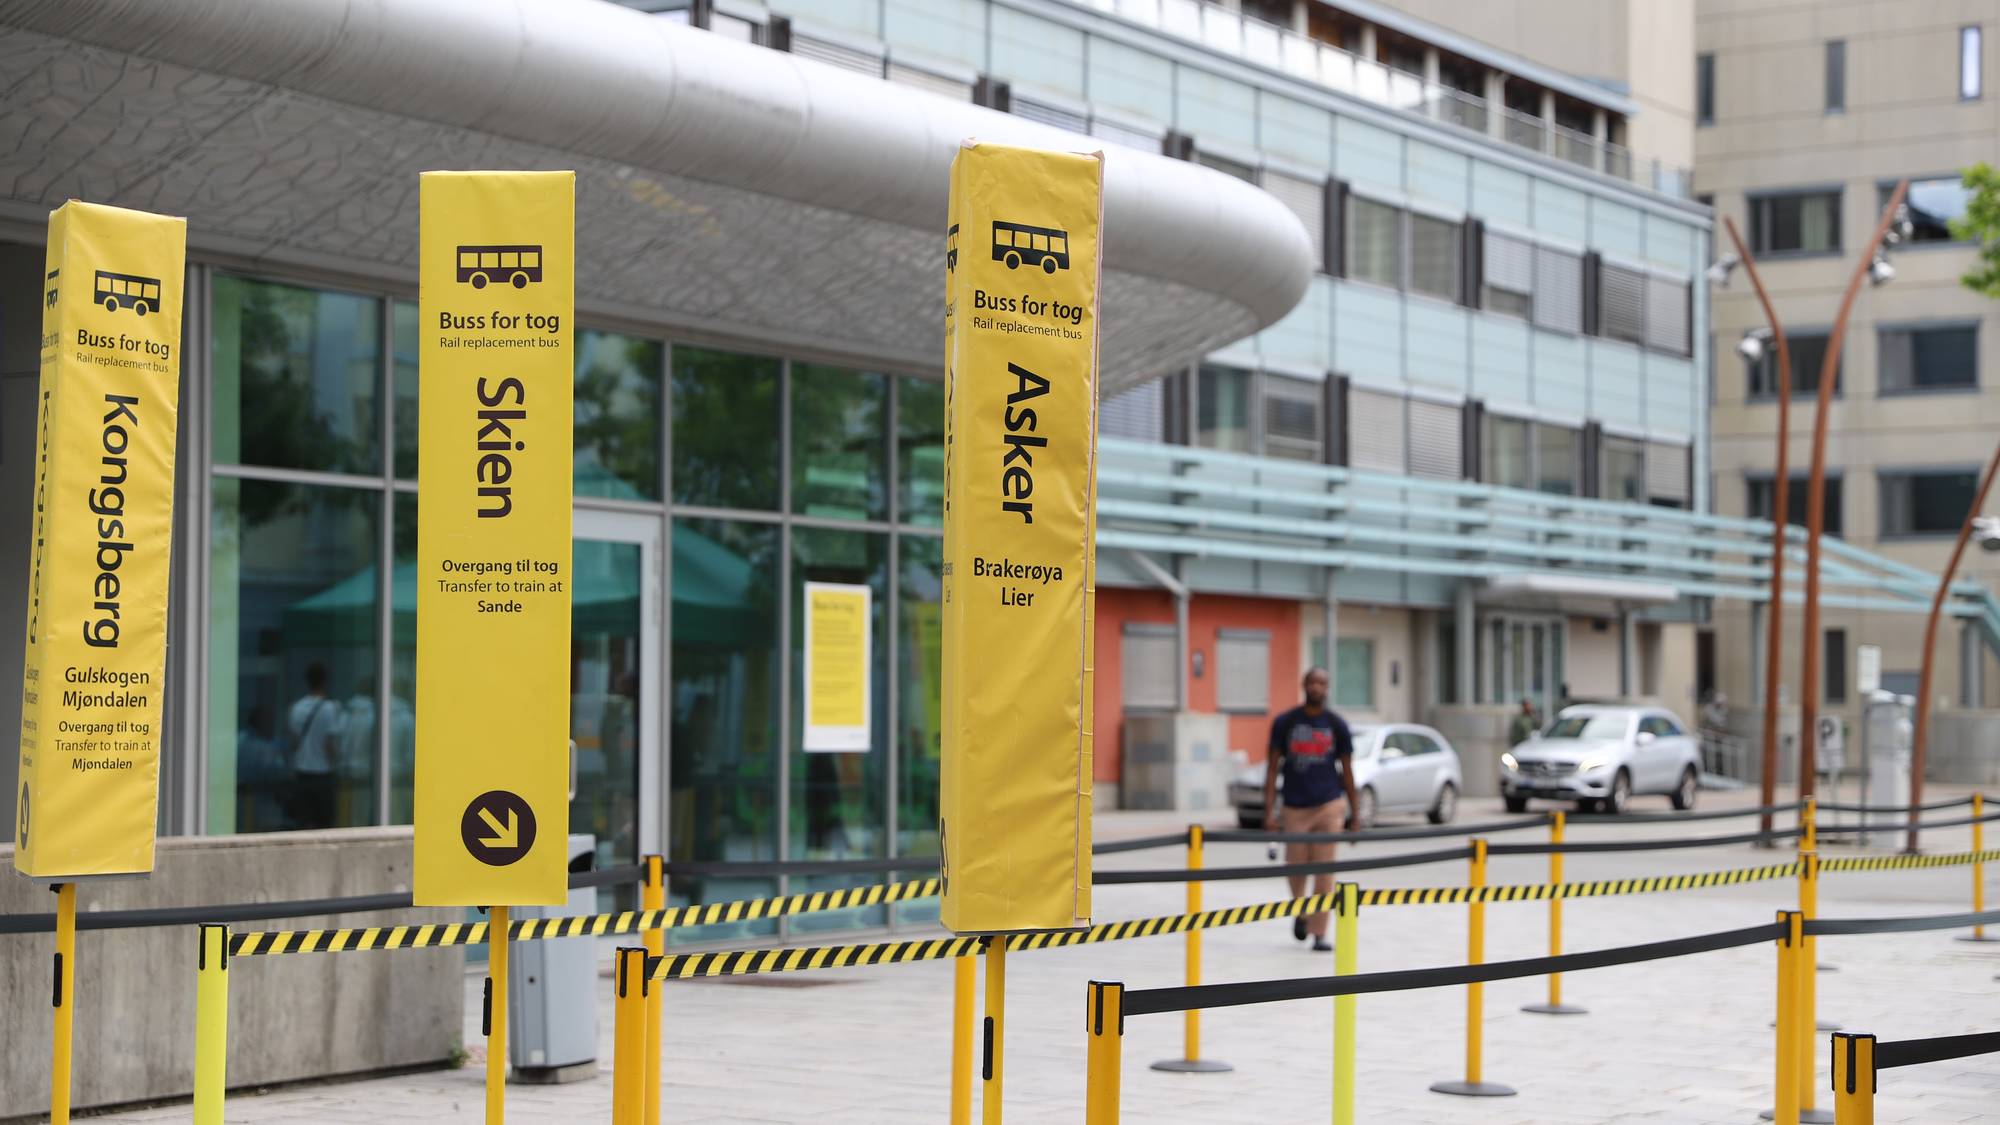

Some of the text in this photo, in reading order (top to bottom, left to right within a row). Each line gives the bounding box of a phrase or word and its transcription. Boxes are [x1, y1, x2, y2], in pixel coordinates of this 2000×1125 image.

[974, 290, 1016, 312] Buss
[1021, 295, 1047, 316] for
[1053, 301, 1083, 325] tog
[439, 311, 560, 333] Buss for tog
[973, 317, 1082, 339] Rail replacement bus
[77, 329, 115, 349] Buss
[119, 334, 141, 352] for
[145, 339, 170, 360] tog
[440, 337, 560, 350] Rail replacement bus
[76, 352, 169, 373] Rail replacement bus
[477, 377, 526, 518] Skien
[1002, 361, 1050, 524] Asker
[83, 394, 139, 648] Kongsberg
[442, 559, 558, 576] Overgang til tog
[973, 557, 1063, 585] Brakerøya
[438, 579, 562, 593] Transfer to train at
[477, 600, 522, 613] Sande
[1001, 587, 1035, 607] Lier
[65, 667, 150, 688] Gulskogen
[62, 691, 147, 711] Mjøndalen
[59, 721, 150, 735] Overgang til tog
[55, 739, 151, 751] Transfer to train at
[72, 758, 133, 773] Mjøndalen
